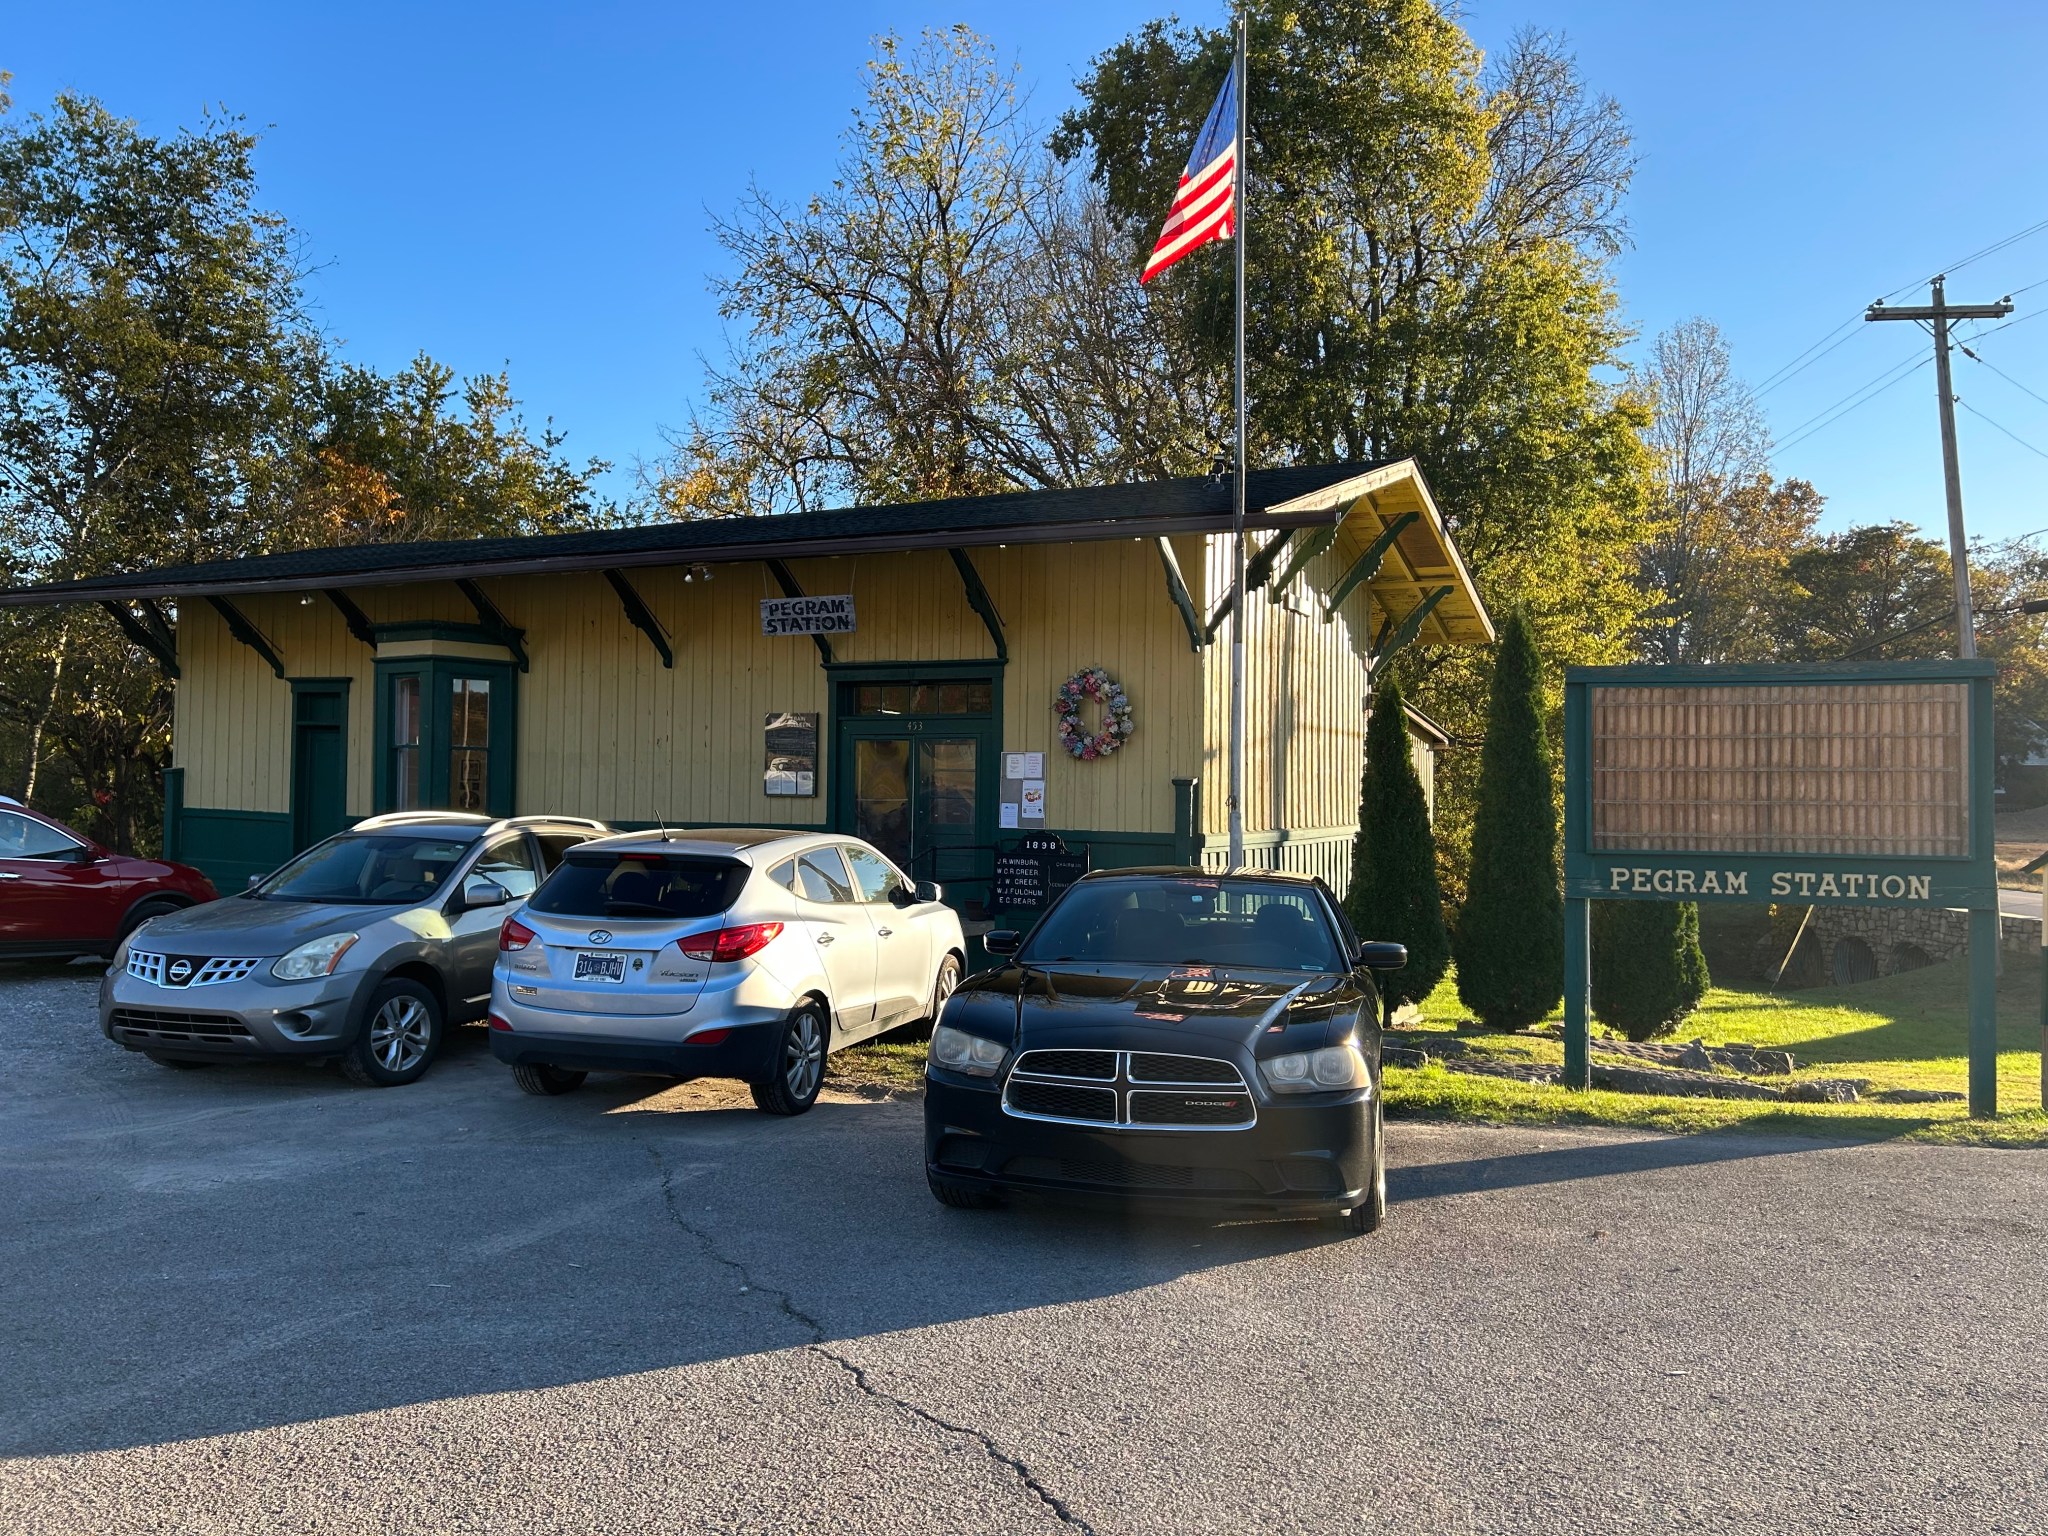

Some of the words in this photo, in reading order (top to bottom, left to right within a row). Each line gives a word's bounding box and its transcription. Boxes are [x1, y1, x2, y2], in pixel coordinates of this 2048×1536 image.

[768, 600, 845, 616] PEGRAM
[766, 615, 850, 633] STATION
[907, 721, 923, 731] 453
[1026, 841, 1056, 849] 1898
[1610, 867, 1748, 894] PEGRAM
[1771, 872, 1931, 899] STATION
[577, 960, 593, 974] 314
